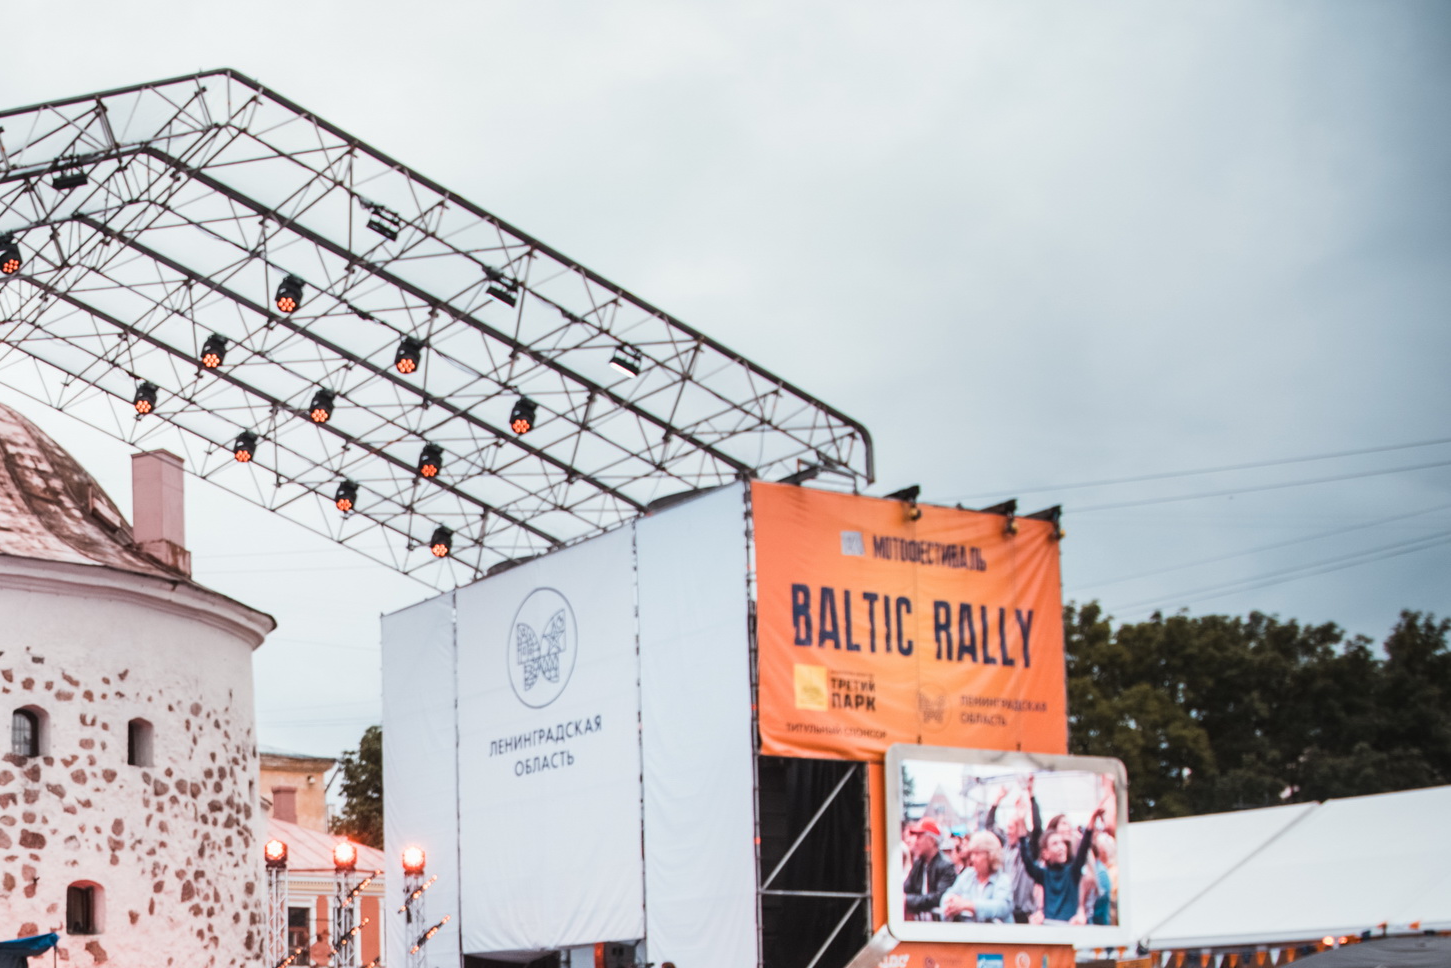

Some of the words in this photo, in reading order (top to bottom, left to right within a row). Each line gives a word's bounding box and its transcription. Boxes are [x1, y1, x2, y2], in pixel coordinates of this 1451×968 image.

[791, 583, 914, 657] BALTIC
[933, 600, 1035, 669] RALLY
[831, 693, 877, 712] ПАРК
[489, 714, 602, 758] ЛЕНИНГРАДСКАЯ
[514, 749, 575, 777] ОБЛАСТЬ
